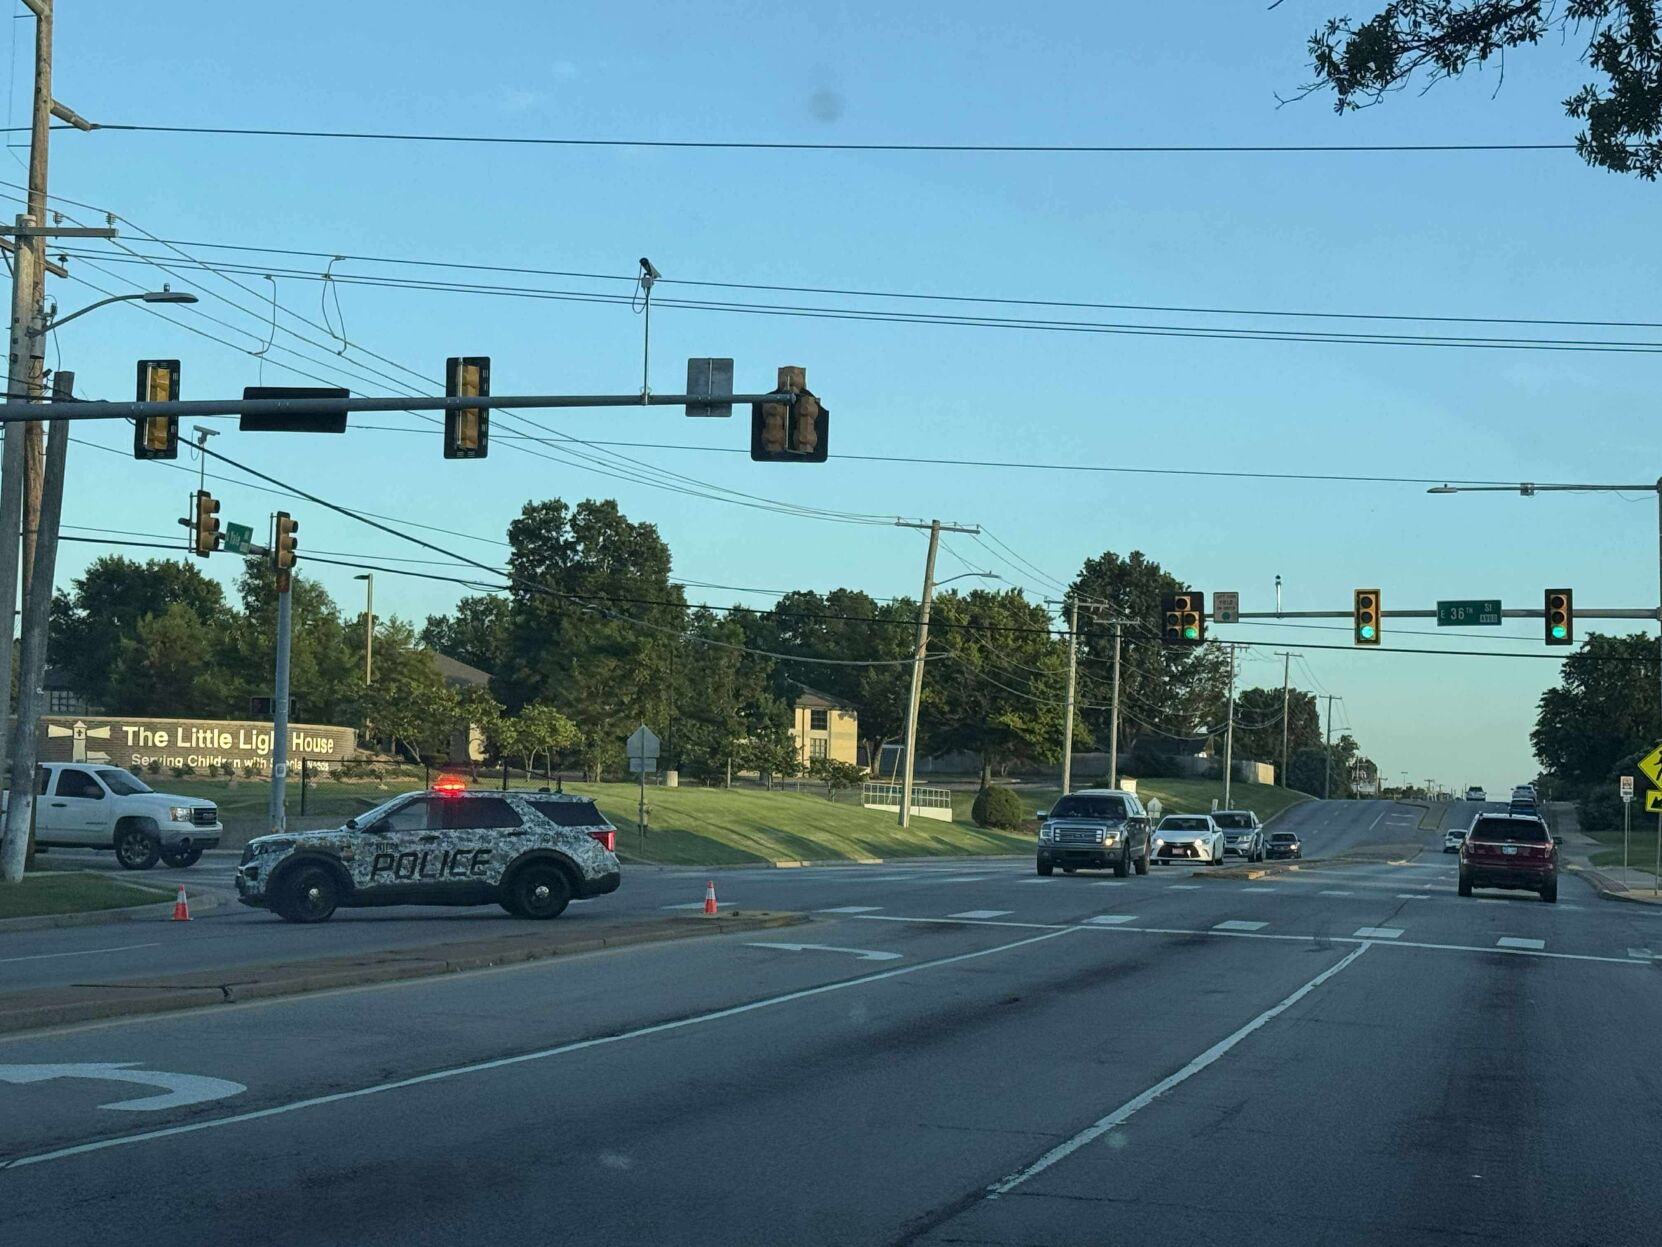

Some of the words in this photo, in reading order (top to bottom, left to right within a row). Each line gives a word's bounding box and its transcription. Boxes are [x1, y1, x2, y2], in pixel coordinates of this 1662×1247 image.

[122, 726, 169, 747] The
[177, 727, 232, 749] Little
[239, 729, 275, 755] Lig
[292, 731, 334, 754] House
[370, 848, 492, 880] POLICE
